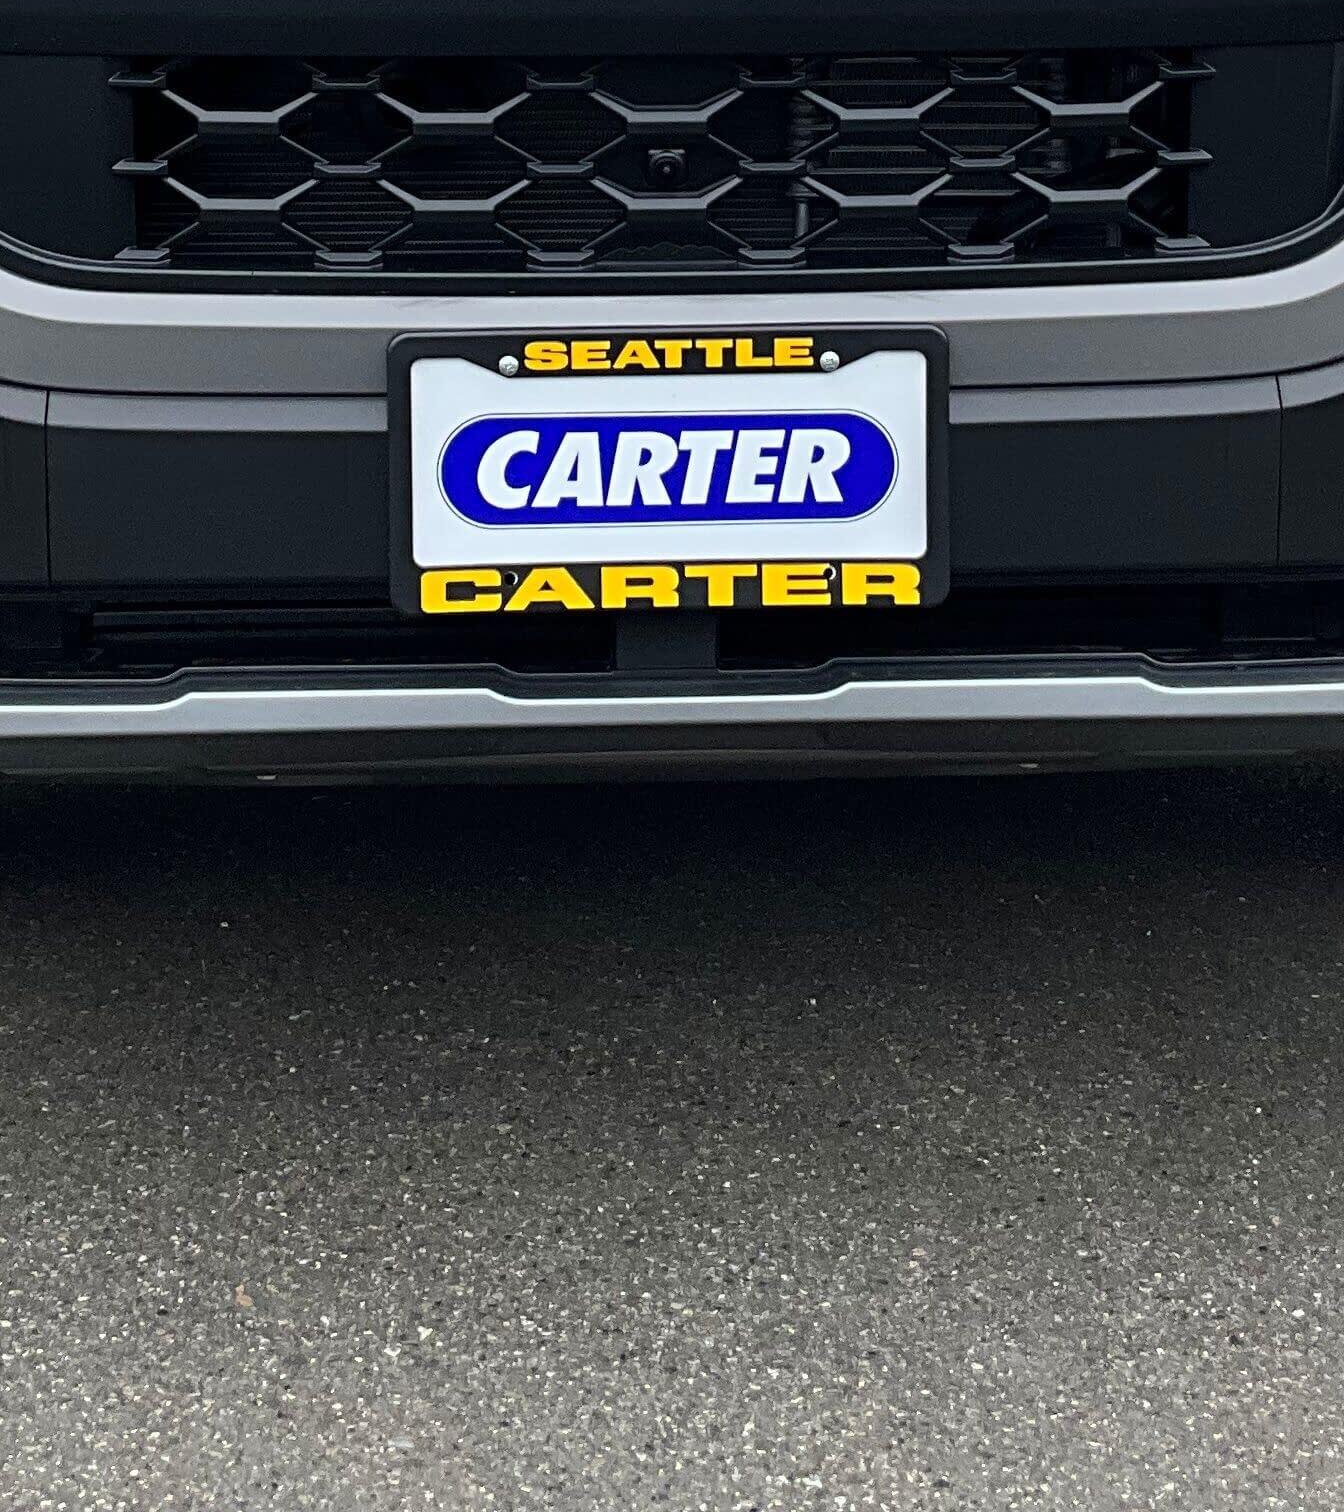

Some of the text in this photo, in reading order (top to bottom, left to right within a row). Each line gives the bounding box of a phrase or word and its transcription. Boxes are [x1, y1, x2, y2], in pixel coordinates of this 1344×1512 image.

[523, 337, 815, 371] SEATTLE
[476, 428, 852, 510] CARTER
[420, 562, 921, 615] CARTER
